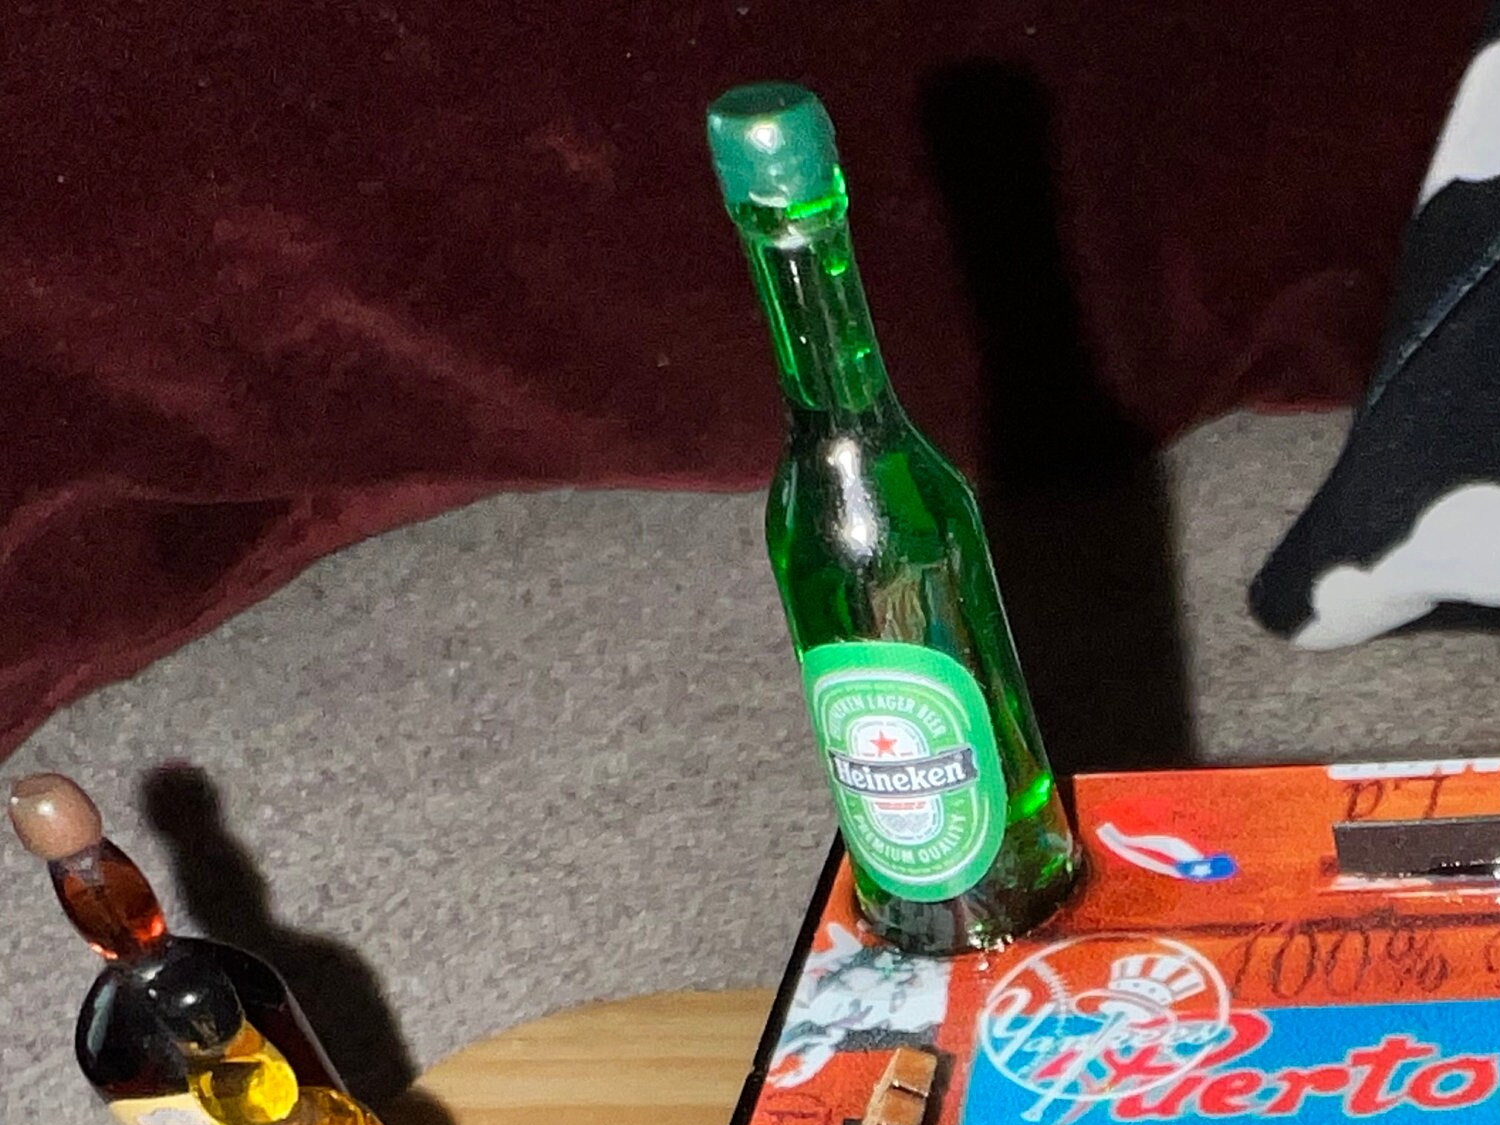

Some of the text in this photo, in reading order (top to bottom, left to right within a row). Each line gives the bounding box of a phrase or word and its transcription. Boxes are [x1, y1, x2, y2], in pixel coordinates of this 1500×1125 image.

[866, 694, 916, 714] LAGER
[916, 703, 947, 739] BEER
[834, 755, 967, 793] Heineken
[1230, 920, 1450, 1000] 100%
